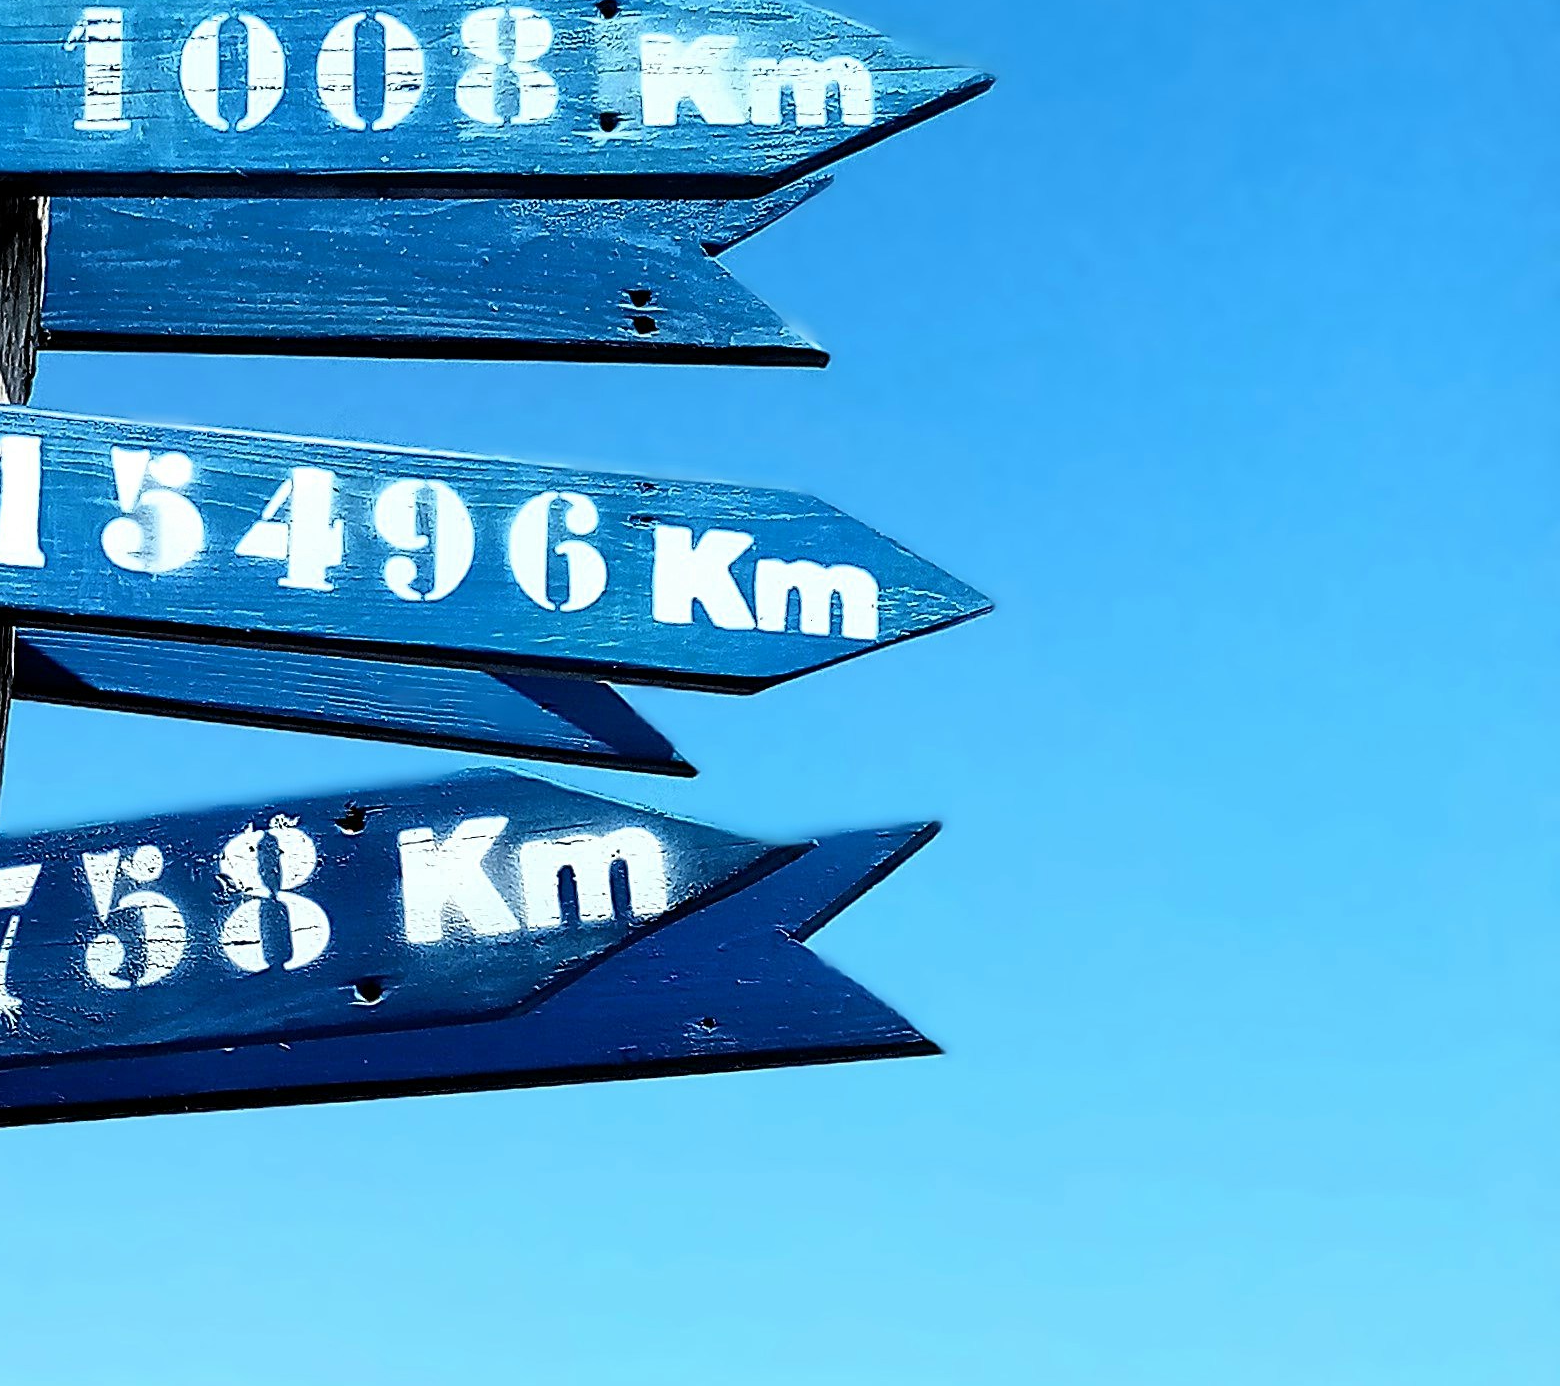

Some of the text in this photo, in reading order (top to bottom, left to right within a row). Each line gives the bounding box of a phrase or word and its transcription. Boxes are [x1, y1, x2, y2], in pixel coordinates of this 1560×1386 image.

[66, 6, 561, 134] 1008
[639, 33, 877, 127] Km
[651, 525, 880, 643] Km
[397, 816, 668, 944] Km
